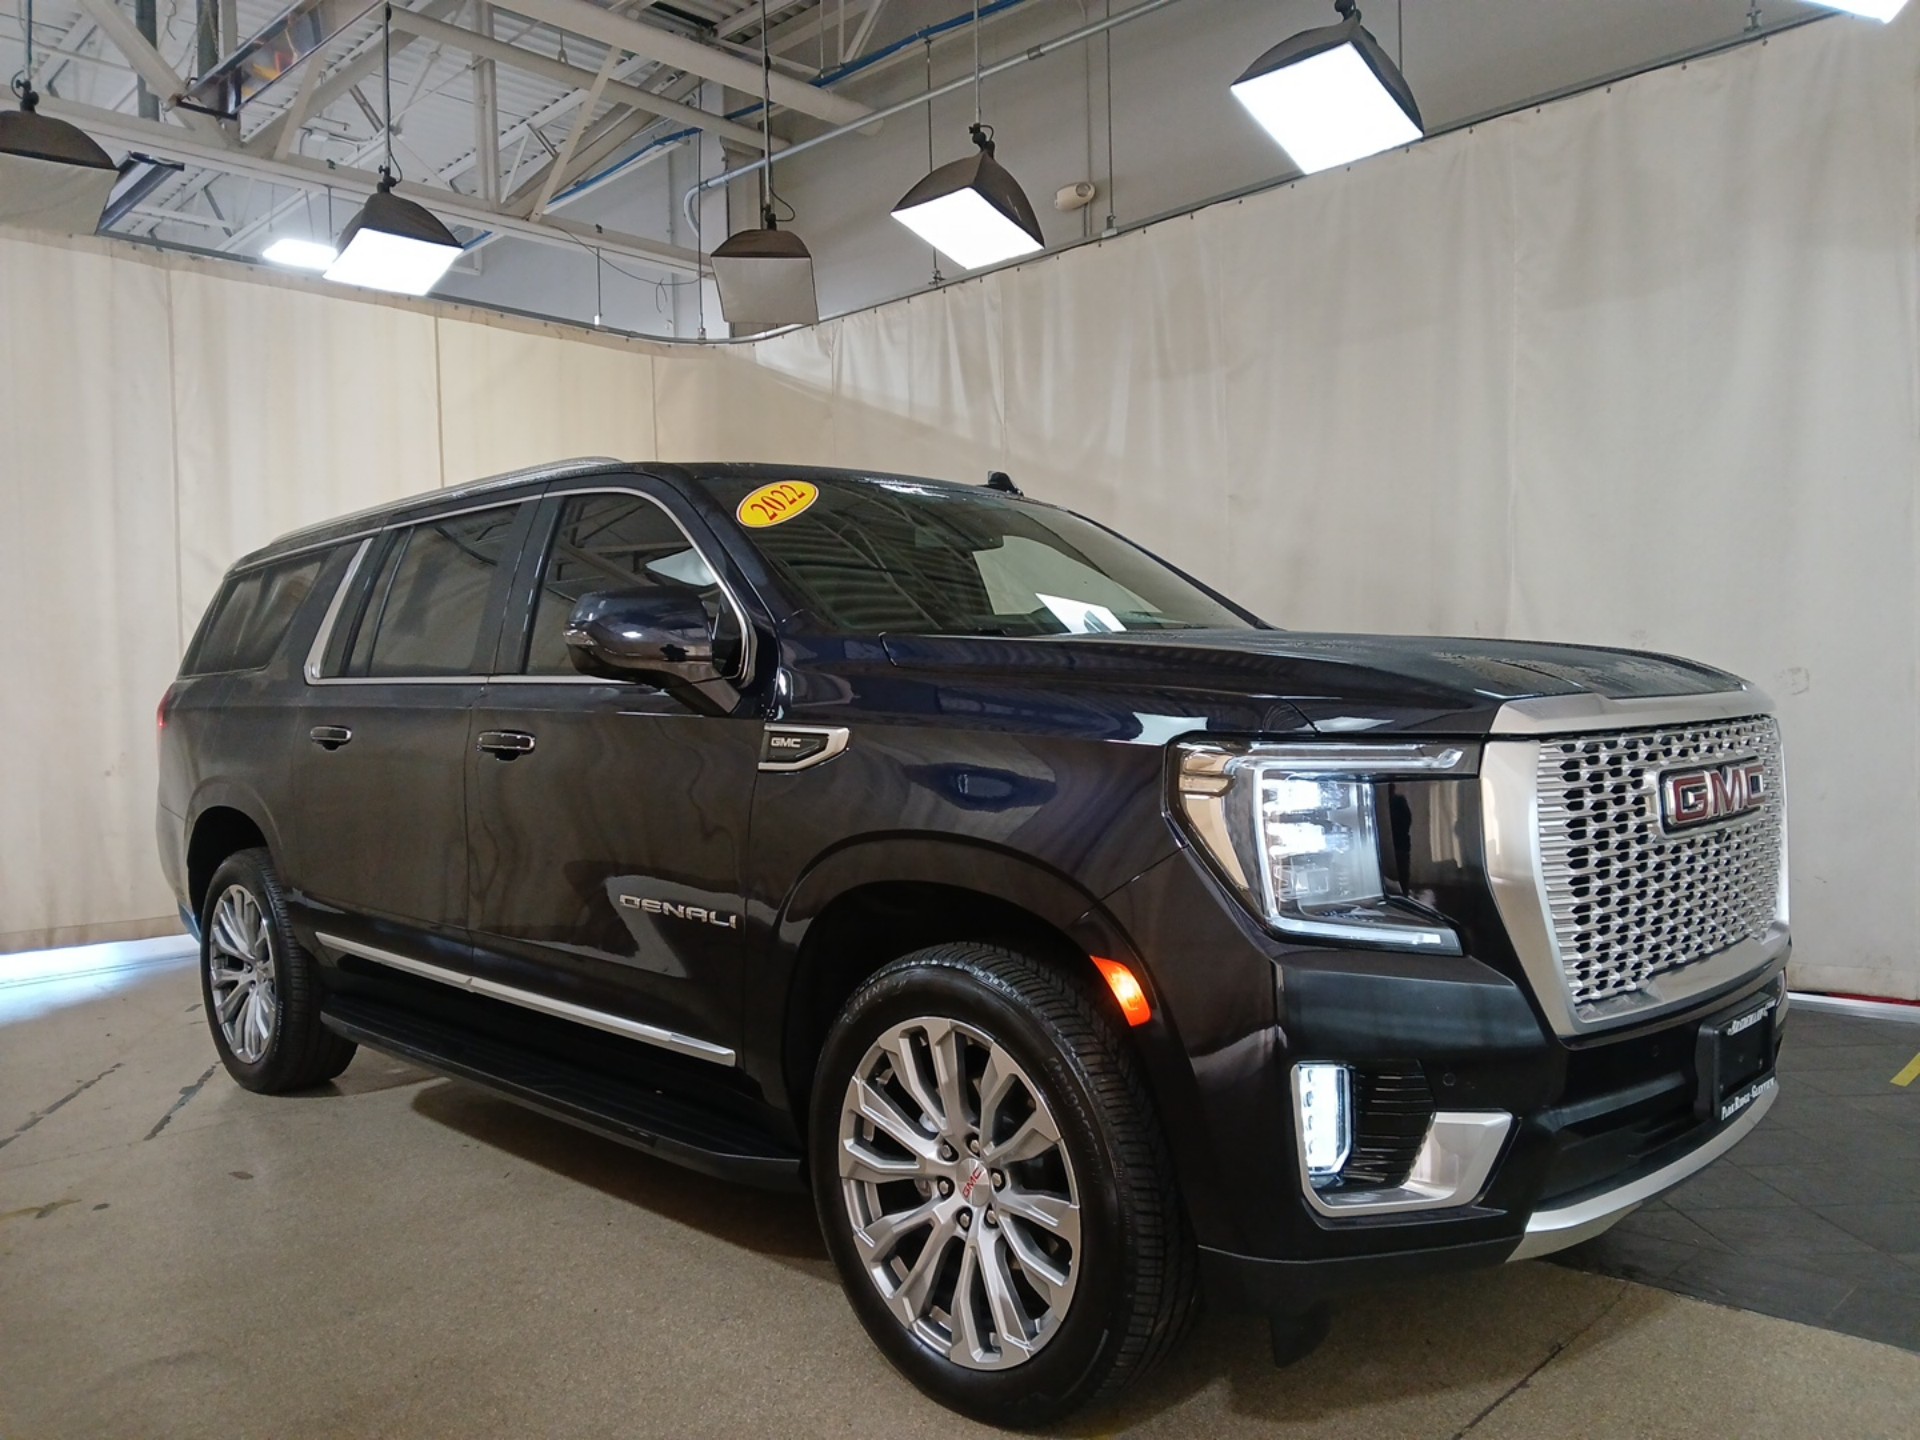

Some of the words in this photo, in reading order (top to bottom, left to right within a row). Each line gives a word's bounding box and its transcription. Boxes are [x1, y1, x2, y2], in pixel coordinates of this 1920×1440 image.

[750, 484, 806, 521] 2022
[770, 736, 802, 748] GMC
[1665, 764, 1766, 824] GMC
[619, 893, 737, 929] DENALI
[962, 1167, 982, 1199] GMC
